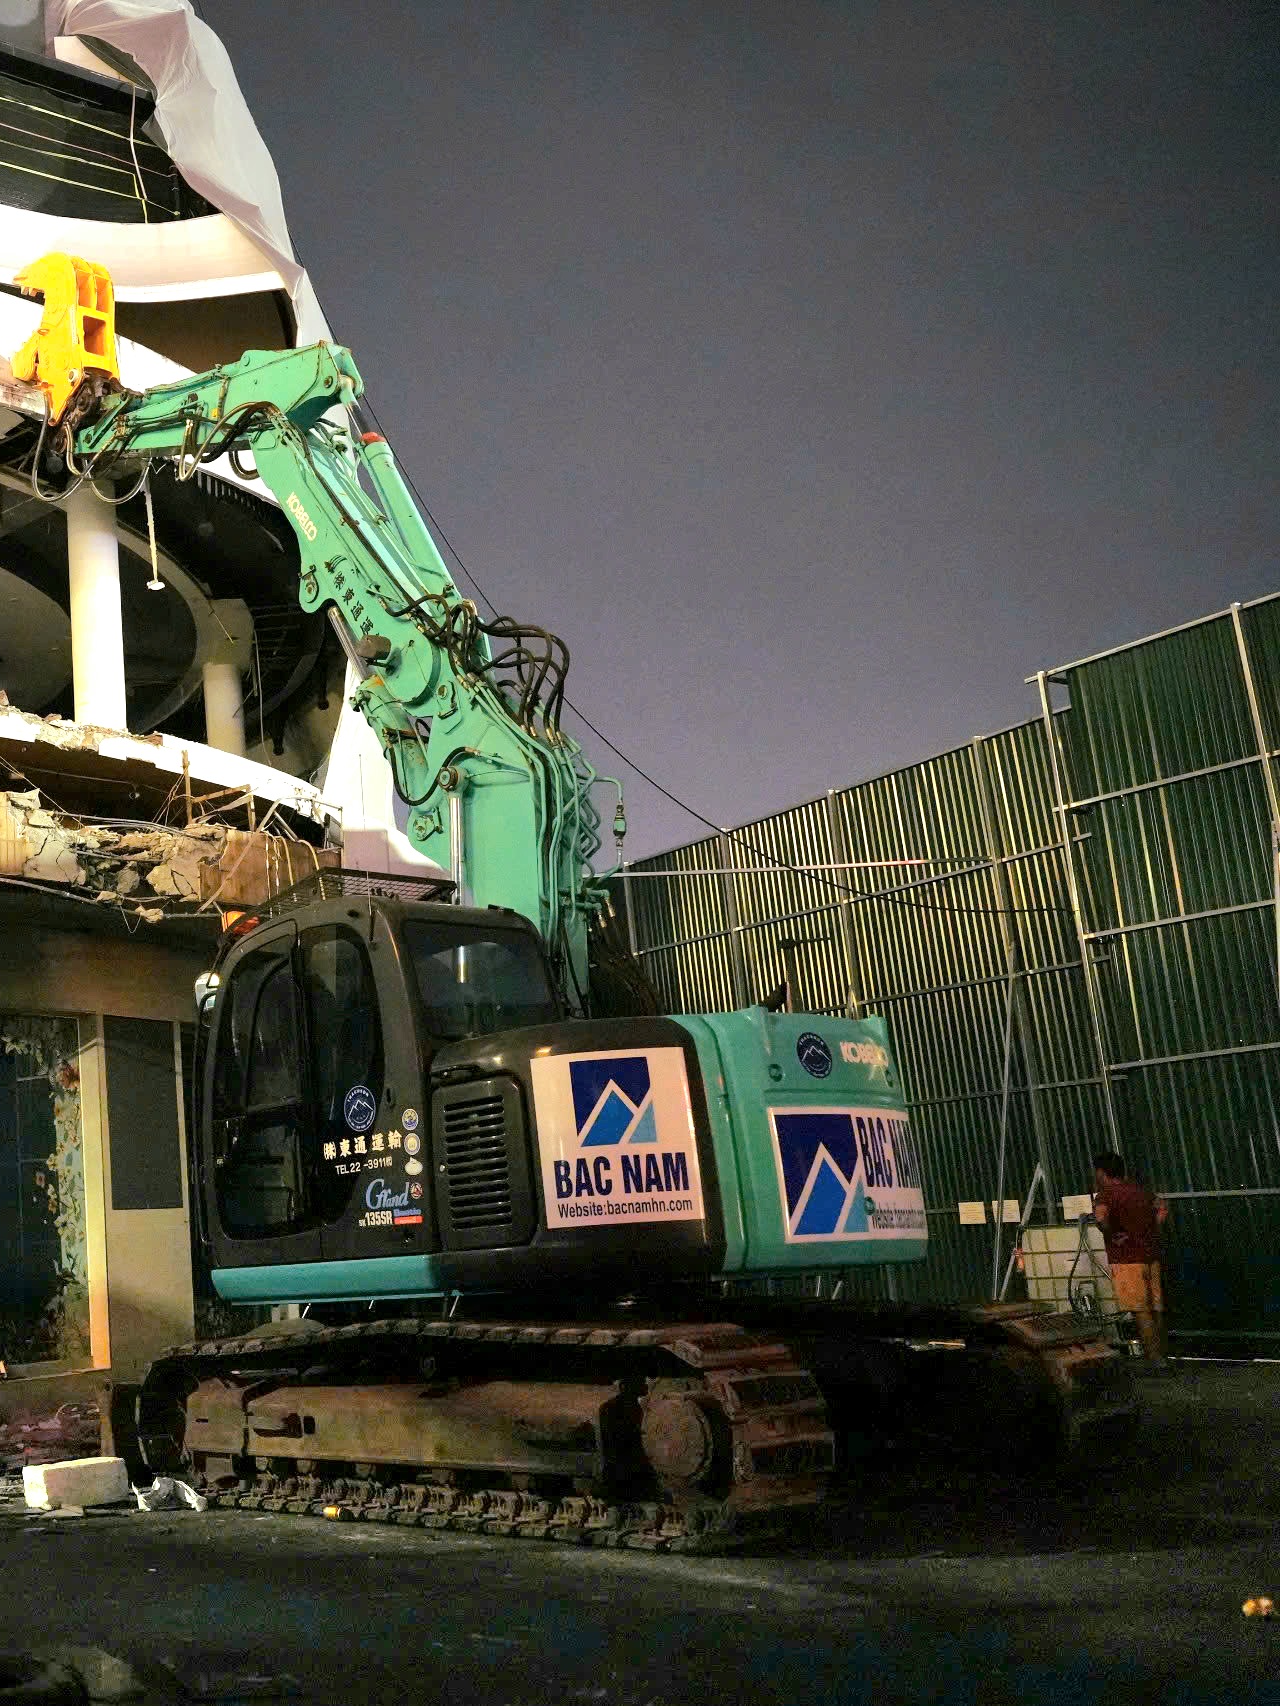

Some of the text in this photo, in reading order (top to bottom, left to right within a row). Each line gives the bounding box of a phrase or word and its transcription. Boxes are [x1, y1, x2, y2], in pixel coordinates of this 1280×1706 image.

[286, 491, 318, 542] KOBELCO
[553, 1152, 690, 1199] BAC NAM
[855, 1116, 893, 1188] BAC
